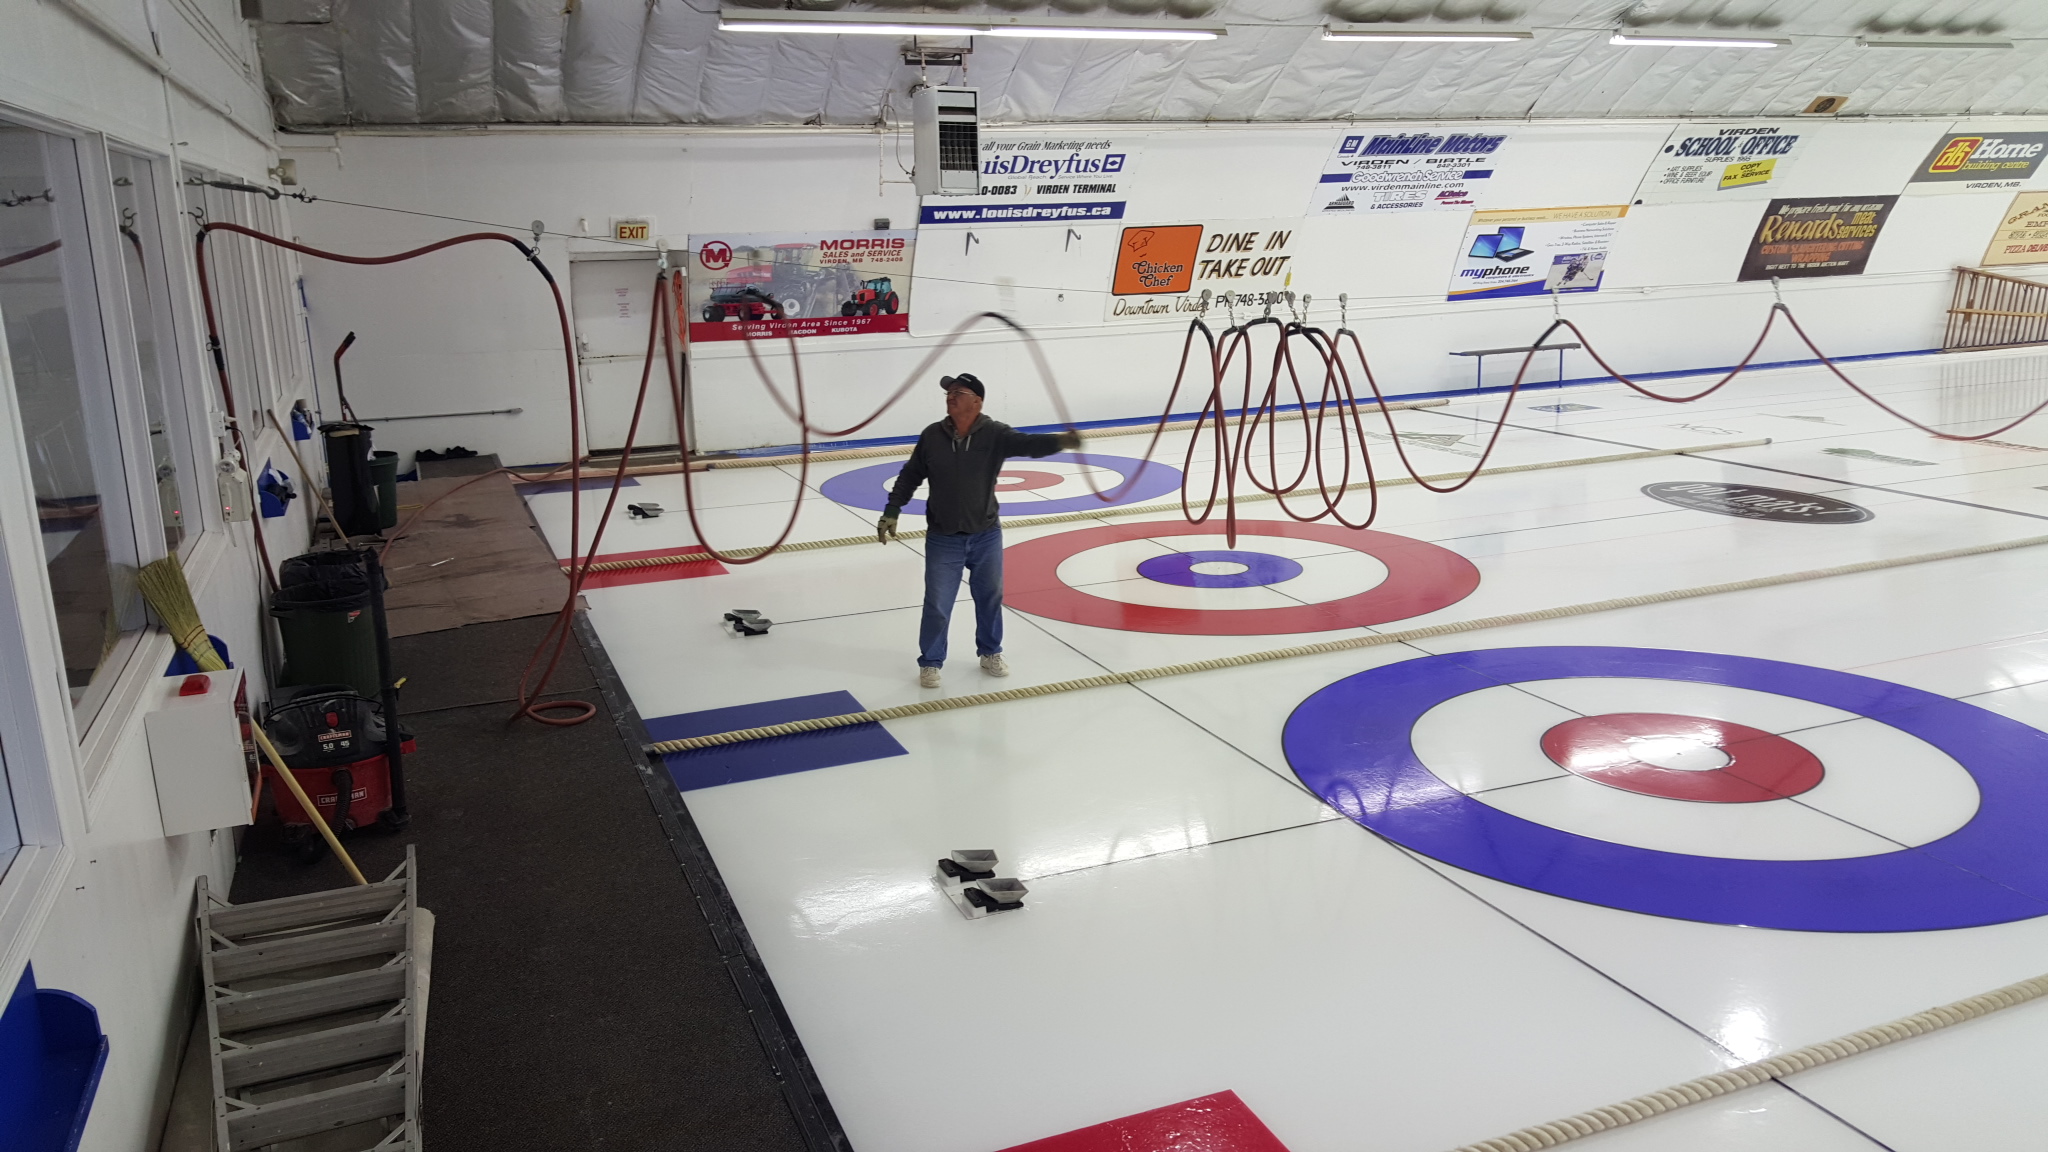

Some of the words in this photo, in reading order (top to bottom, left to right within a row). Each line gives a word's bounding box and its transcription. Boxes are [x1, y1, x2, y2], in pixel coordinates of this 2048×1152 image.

[1719, 127, 1780, 136] VIRDEN
[982, 141, 996, 151] all
[993, 142, 1016, 153] your
[1017, 141, 1040, 151] Grain
[1041, 140, 1085, 152] Marketing
[1084, 140, 1112, 150] needs
[1346, 140, 1359, 148] GM
[1358, 133, 1444, 158] MainLine
[1434, 133, 1508, 154] Motors
[1674, 136, 1741, 156] SCHOOL
[1740, 135, 1800, 155] OFFICE
[1969, 138, 2043, 159] Home
[981, 153, 1101, 179] uisDreyfus
[1740, 162, 1762, 170] COPY
[1351, 170, 1423, 183] Goodwrench
[1424, 168, 1463, 180] Service
[1740, 170, 1771, 178] SERVICE
[1036, 184, 1070, 194] VIRDEN
[1072, 184, 1116, 194] TERMINAL
[1373, 190, 1428, 202] TIRES
[933, 206, 1112, 220] www.louisdreyfus.ca
[1851, 212, 1877, 224] meat
[619, 226, 646, 239] EXIT
[1759, 213, 1844, 244] Renards
[1836, 224, 1878, 239] services
[820, 238, 905, 250] MORRIS
[1206, 232, 1259, 253] DINE
[1263, 230, 1292, 251] IN
[2003, 244, 2026, 254] PIZZA
[1132, 260, 1183, 274] Chicken
[1197, 258, 1250, 280] TAKE
[1250, 256, 1291, 276] OUT
[1460, 266, 1530, 279] myphone
[1139, 274, 1174, 287] Chef
[1113, 298, 1170, 316] Downtown
[1235, 292, 1283, 307] 748-30
[320, 790, 365, 804] CRAAN
